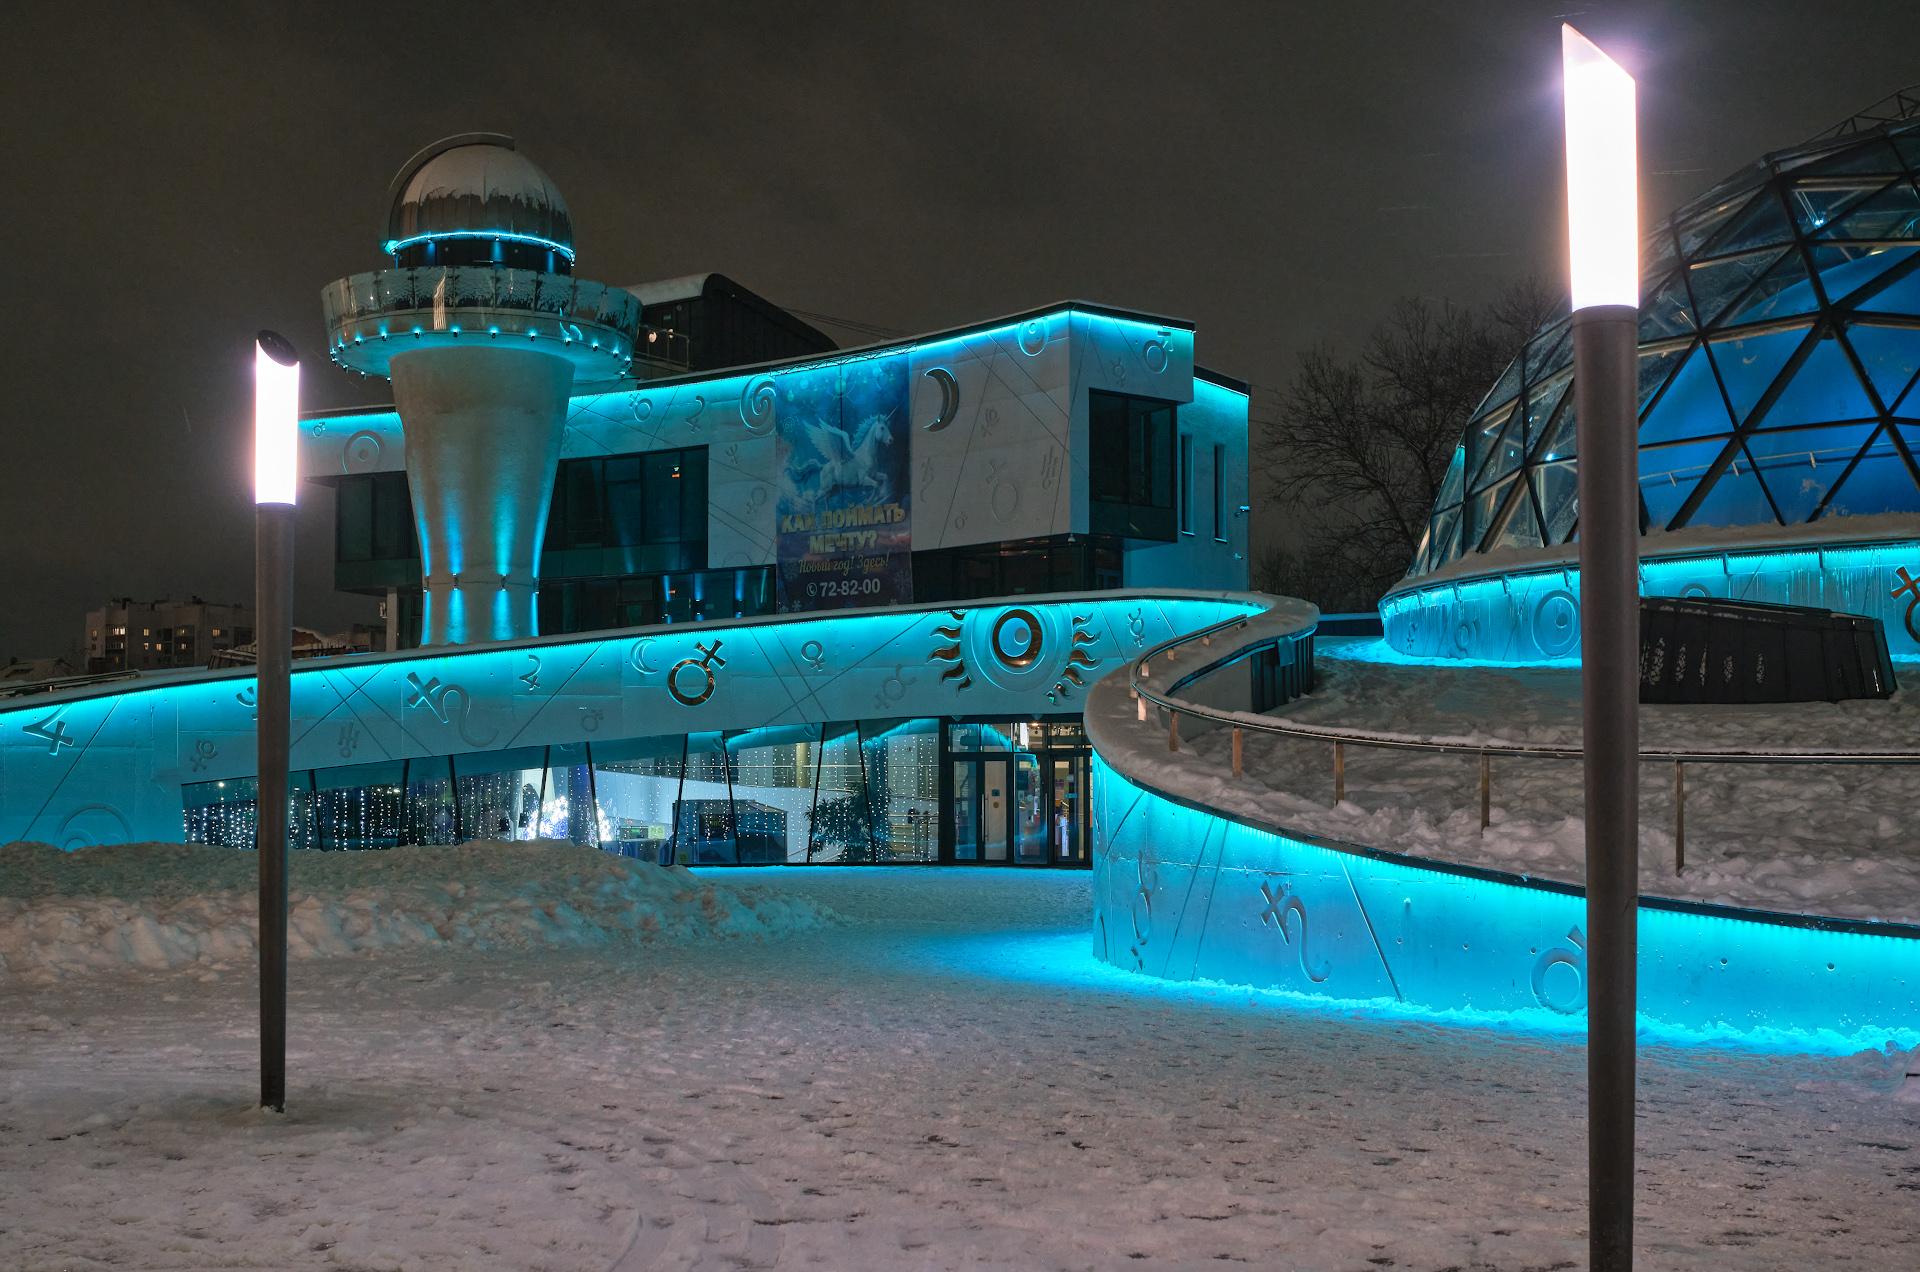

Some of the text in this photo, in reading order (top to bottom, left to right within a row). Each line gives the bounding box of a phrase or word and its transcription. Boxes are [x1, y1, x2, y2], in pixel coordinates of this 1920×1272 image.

[782, 502, 905, 533] КАК ПОЙМАТЬ
[809, 530, 878, 553] МЕЧТУ?
[798, 551, 889, 577] Новый год! Здесь!
[819, 578, 880, 597] 72-82-00
